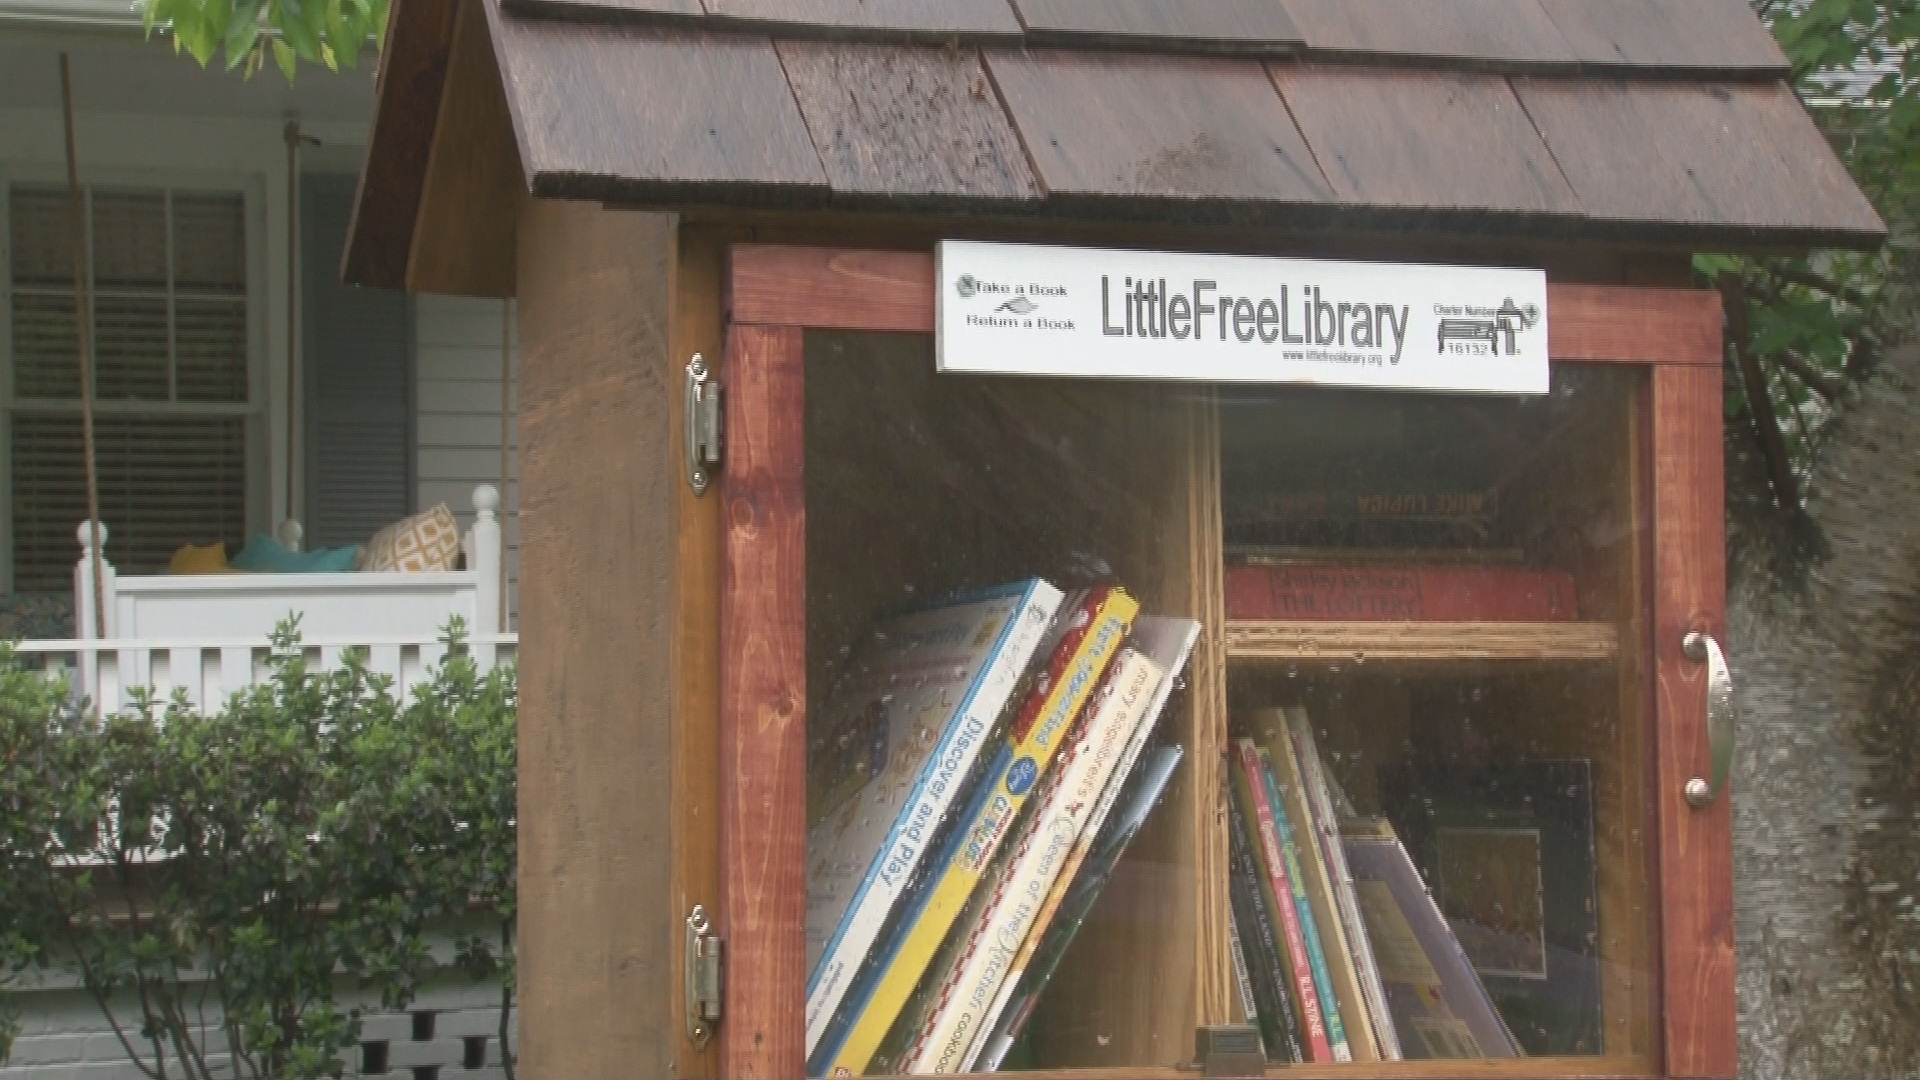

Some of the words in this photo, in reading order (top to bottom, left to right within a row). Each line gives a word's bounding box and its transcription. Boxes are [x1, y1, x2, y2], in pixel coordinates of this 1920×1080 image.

[976, 281, 1010, 294] Take
[1015, 284, 1025, 294] a
[1029, 283, 1067, 297] Book
[966, 315, 1018, 328] Return
[1023, 319, 1032, 329] a
[1037, 317, 1075, 331] Book
[1101, 274, 1409, 366] LittleFreeLibrary
[926, 717, 985, 803] Discover
[904, 801, 937, 844] and
[876, 842, 915, 887] Play
[1024, 879, 1044, 901] of
[934, 1012, 973, 1076] cookboo
